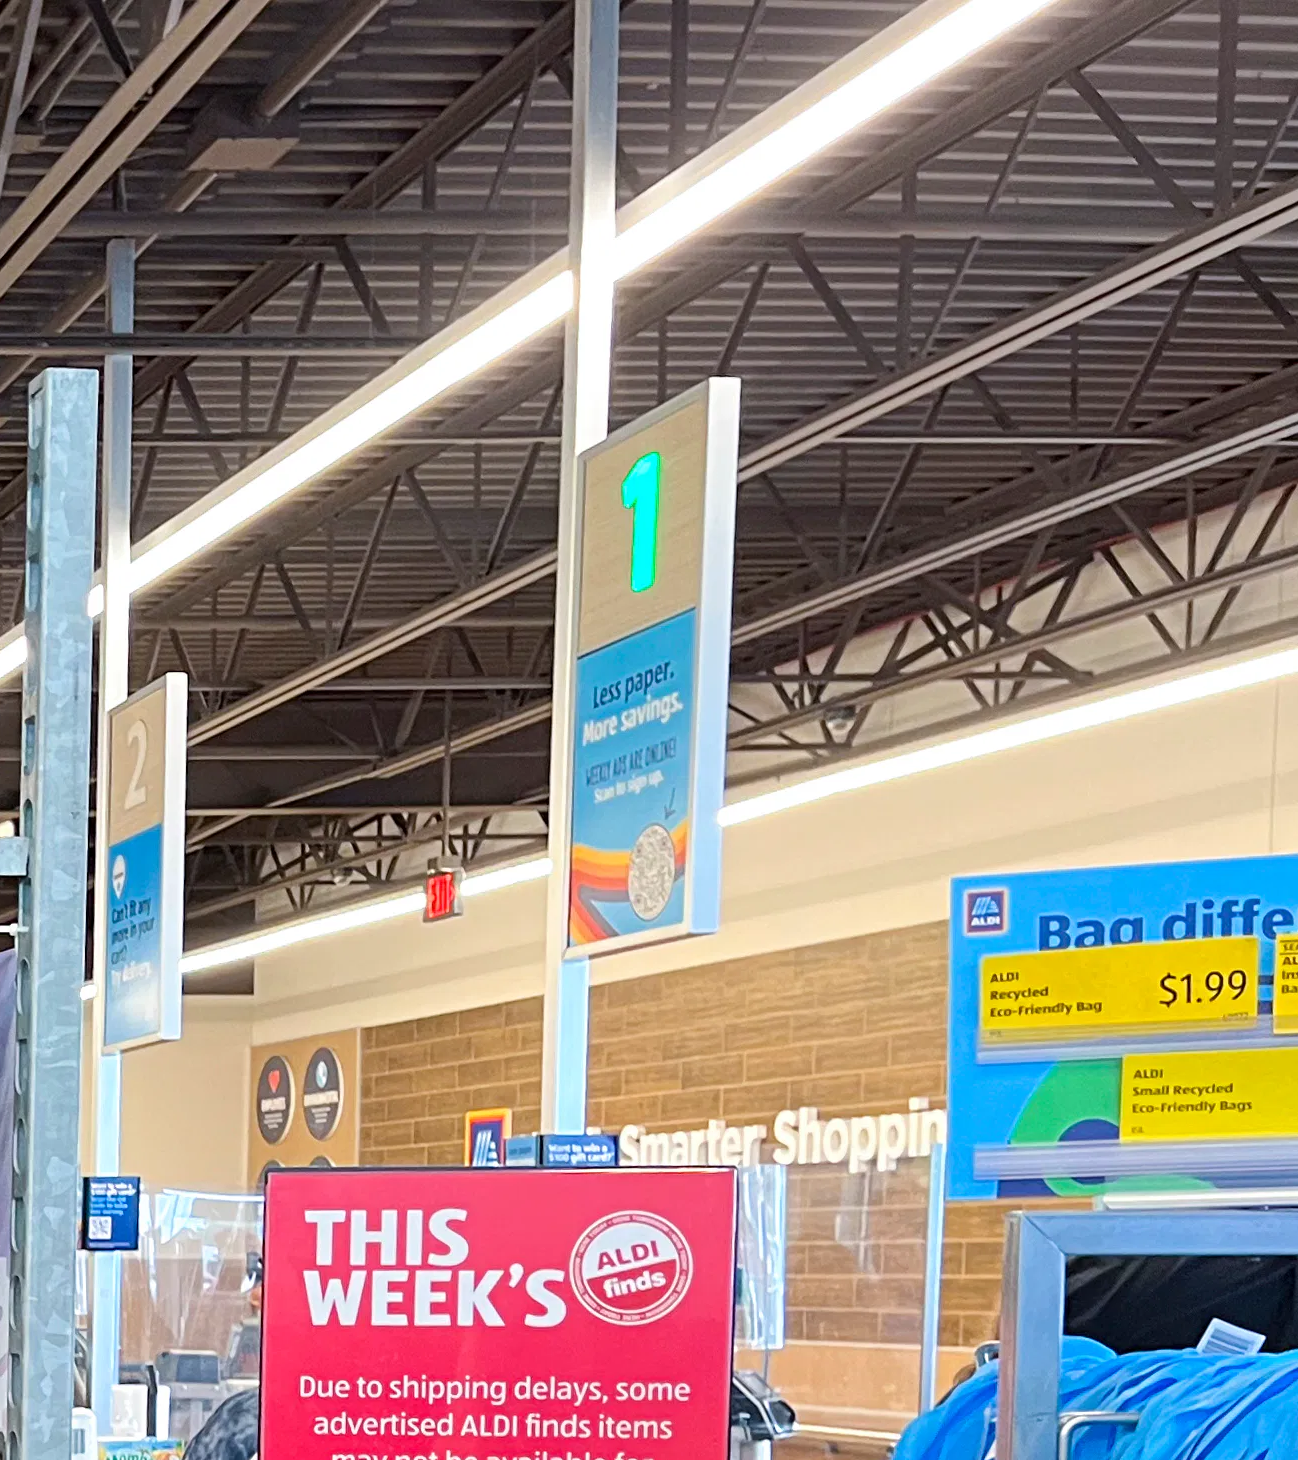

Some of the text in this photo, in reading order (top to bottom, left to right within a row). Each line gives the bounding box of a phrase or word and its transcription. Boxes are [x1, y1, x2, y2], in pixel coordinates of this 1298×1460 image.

[621, 451, 661, 592] 1
[593, 661, 674, 708] Less paper.
[583, 692, 683, 746] More savings.
[124, 718, 147, 810] 2
[990, 971, 1020, 983] ALDI
[1159, 969, 1247, 1009] $1.99
[990, 986, 1049, 1002] Recycled
[990, 999, 1102, 1019] Eco-Friendly Bag
[1132, 1083, 1234, 1097] Small Recycled
[1133, 1069, 1164, 1080] ALDI
[1132, 1100, 1253, 1114] Eco-Friendly Bags
[618, 1119, 768, 1167] Smarter
[304, 1208, 469, 1267] THIS
[597, 1240, 660, 1271] ALDI
[303, 1262, 567, 1328] WEEK'S
[603, 1270, 667, 1298] finds
[300, 1375, 691, 1406] Due to shipping delays, some
[313, 1412, 672, 1440] advertised ALDI finds items
